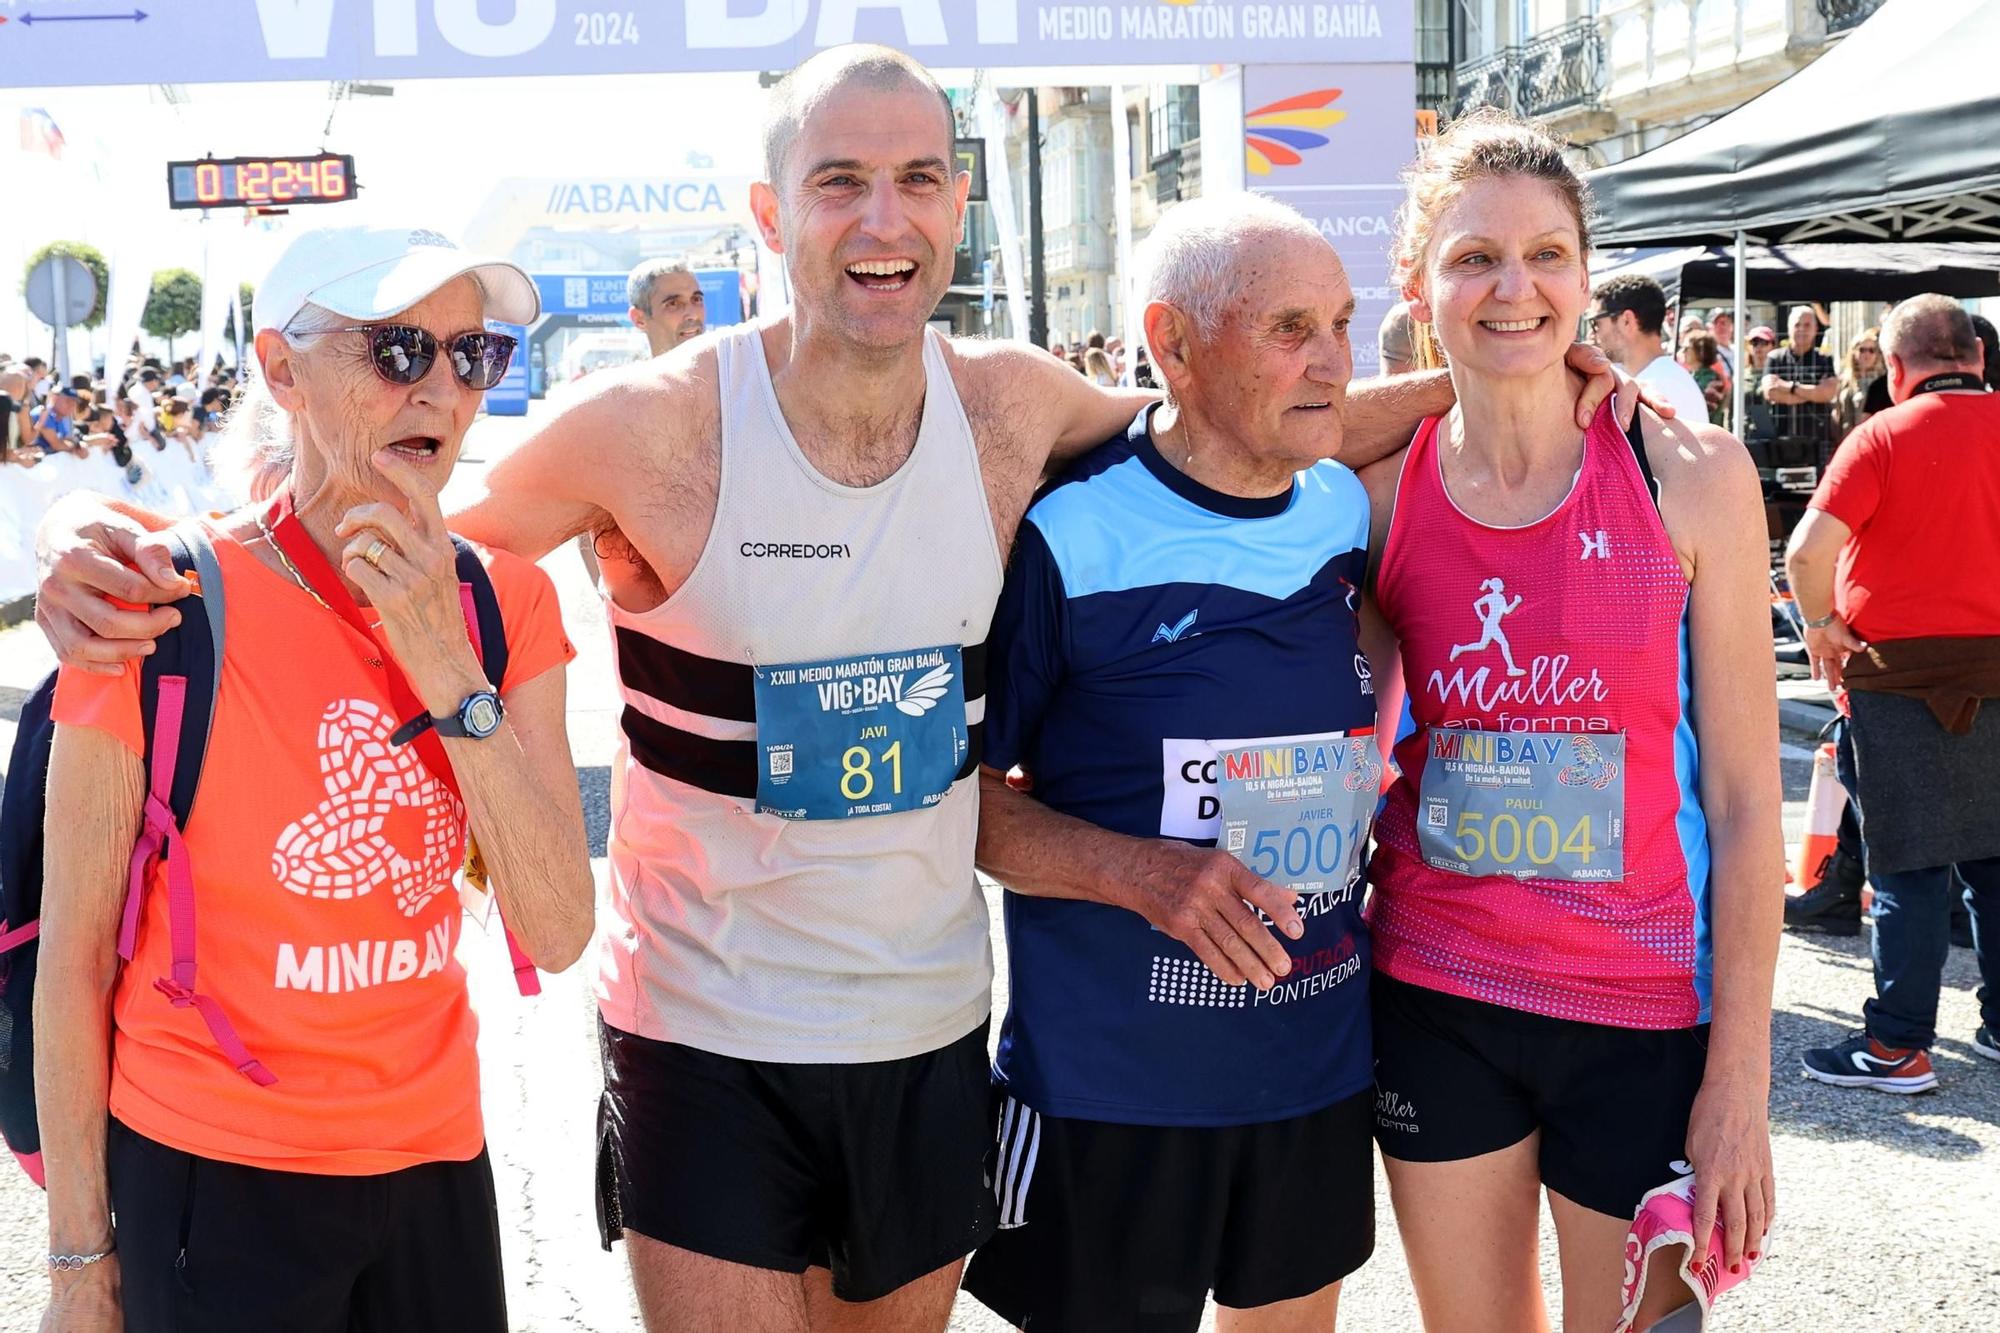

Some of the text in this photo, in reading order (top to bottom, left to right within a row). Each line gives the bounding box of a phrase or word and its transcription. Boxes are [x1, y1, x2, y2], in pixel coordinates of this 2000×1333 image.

[574, 12, 640, 46] 2024
[1038, 5, 1113, 41] MEDIO
[1120, 0, 1235, 40] MARATÓN
[1242, 4, 1305, 39] GRAN
[1313, 0, 1383, 38] BAHÍA
[770, 648, 945, 686] XXIII MEDIO MARATÓN GRAN BAHÍA
[859, 725, 888, 741] JAVI
[1496, 712, 1609, 734] forma
[1224, 743, 1347, 782] MINIBAY
[1433, 731, 1564, 766] MINIBAY
[840, 740, 902, 800] 81
[1298, 807, 1334, 822] JAVIER
[1505, 798, 1543, 811] PAULI
[1454, 811, 1597, 865] 5004
[273, 914, 451, 994] MINIBAY
[1253, 953, 1361, 1008] PONTEVEDRA
[1375, 1090, 1417, 1118] uller
